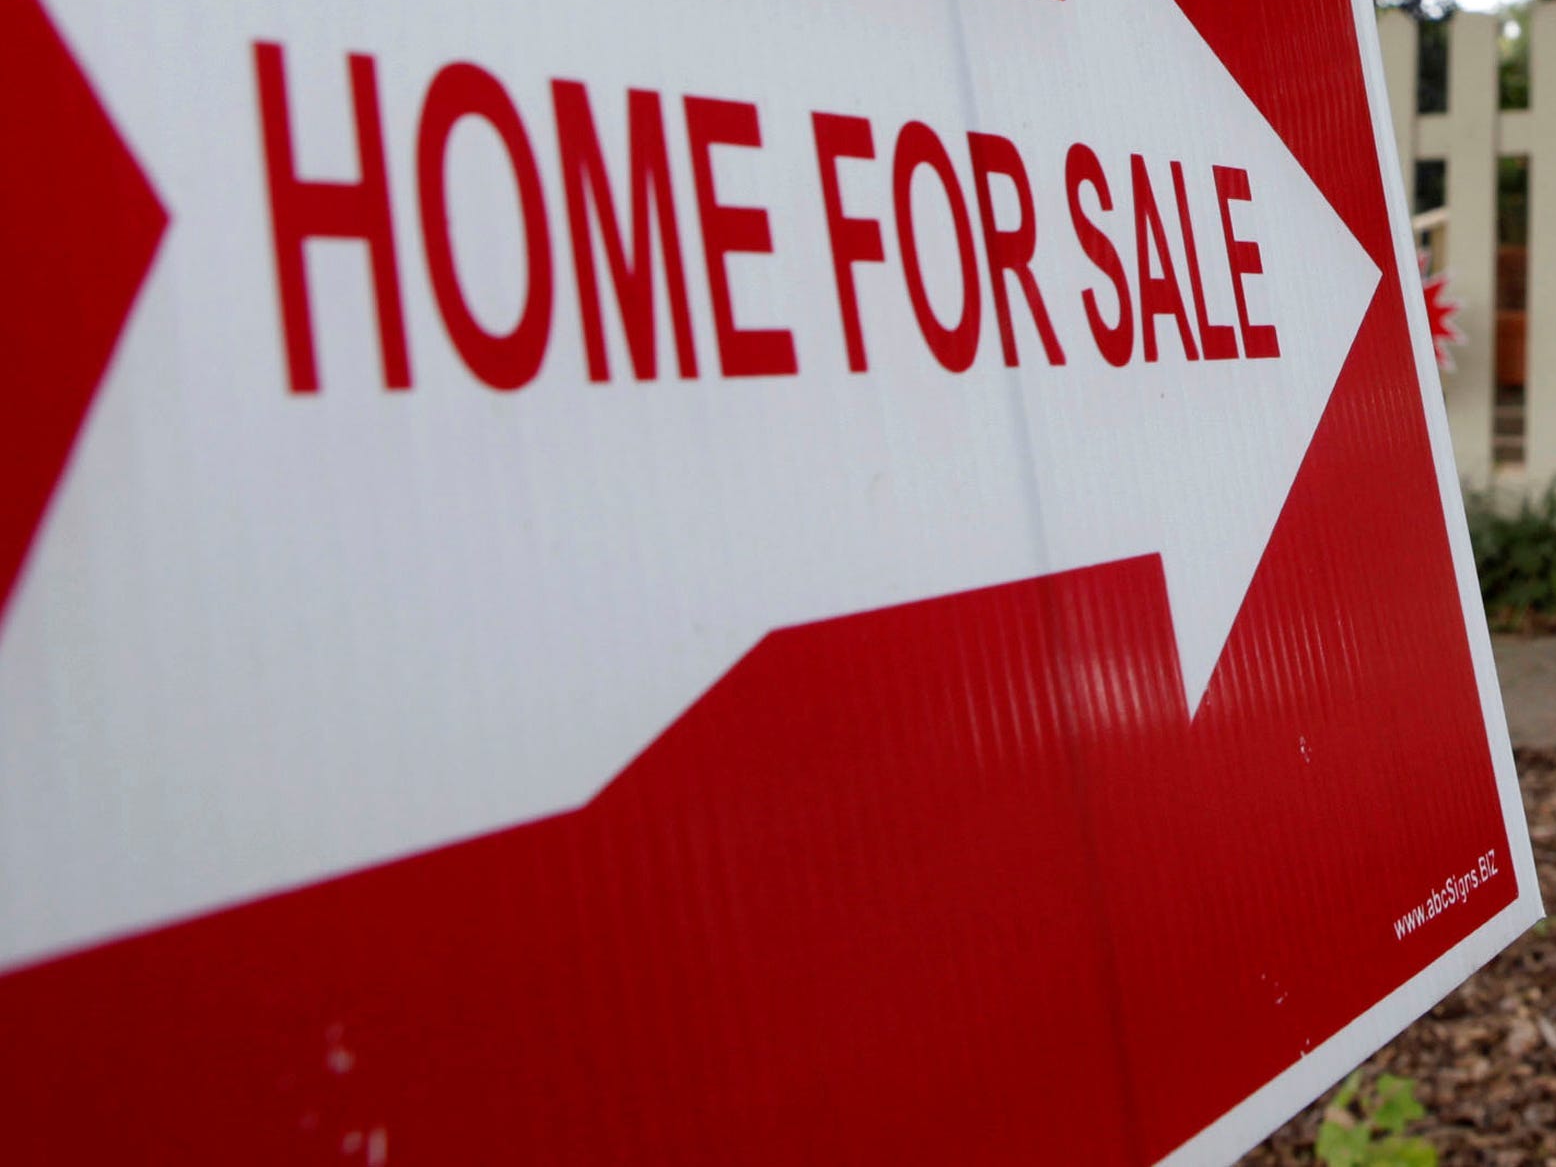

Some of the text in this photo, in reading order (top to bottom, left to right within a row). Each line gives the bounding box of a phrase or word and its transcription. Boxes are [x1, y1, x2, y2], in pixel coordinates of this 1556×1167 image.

[252, 40, 1281, 396] HOME FOR SALE
[1393, 848, 1499, 941] www.abcSigns.BIZ
